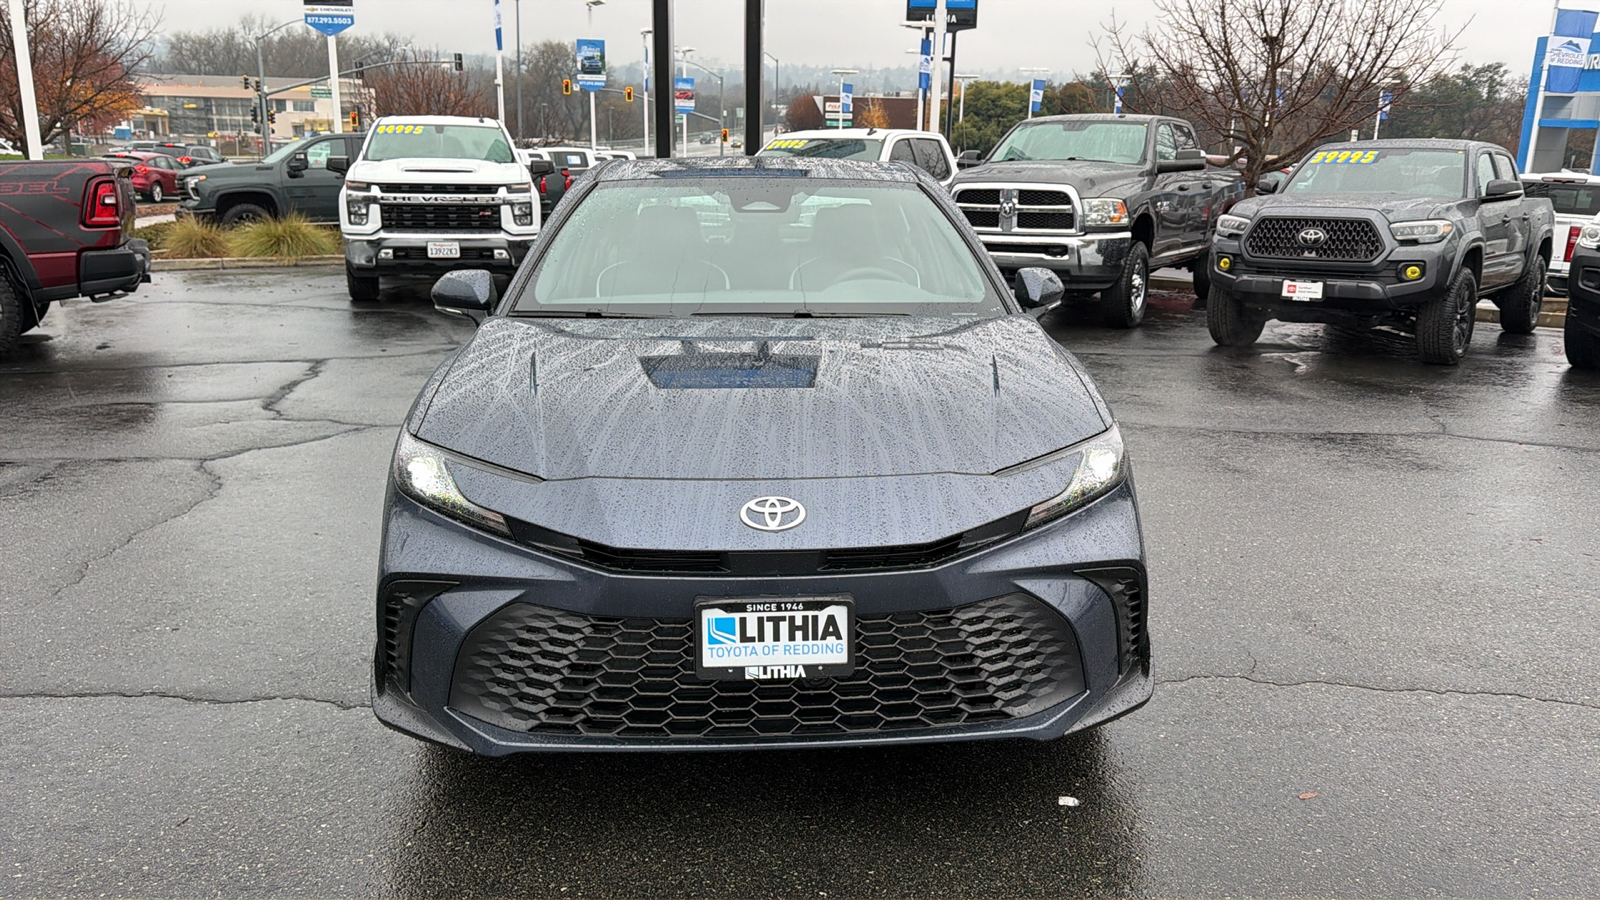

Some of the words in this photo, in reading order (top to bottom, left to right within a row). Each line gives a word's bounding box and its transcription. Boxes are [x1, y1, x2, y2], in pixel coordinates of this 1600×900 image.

[307, 16, 352, 25] 877.293.5503
[1310, 150, 1379, 164] 39995
[430, 247, 458, 256] 13922K3
[746, 604, 777, 612] SINCE
[781, 603, 804, 611] 1946
[739, 614, 843, 643] LITHIA
[707, 646, 759, 658] TOYOTA
[762, 645, 779, 656] OF
[783, 643, 844, 655] REDDING
[759, 665, 807, 679] LITHIA
